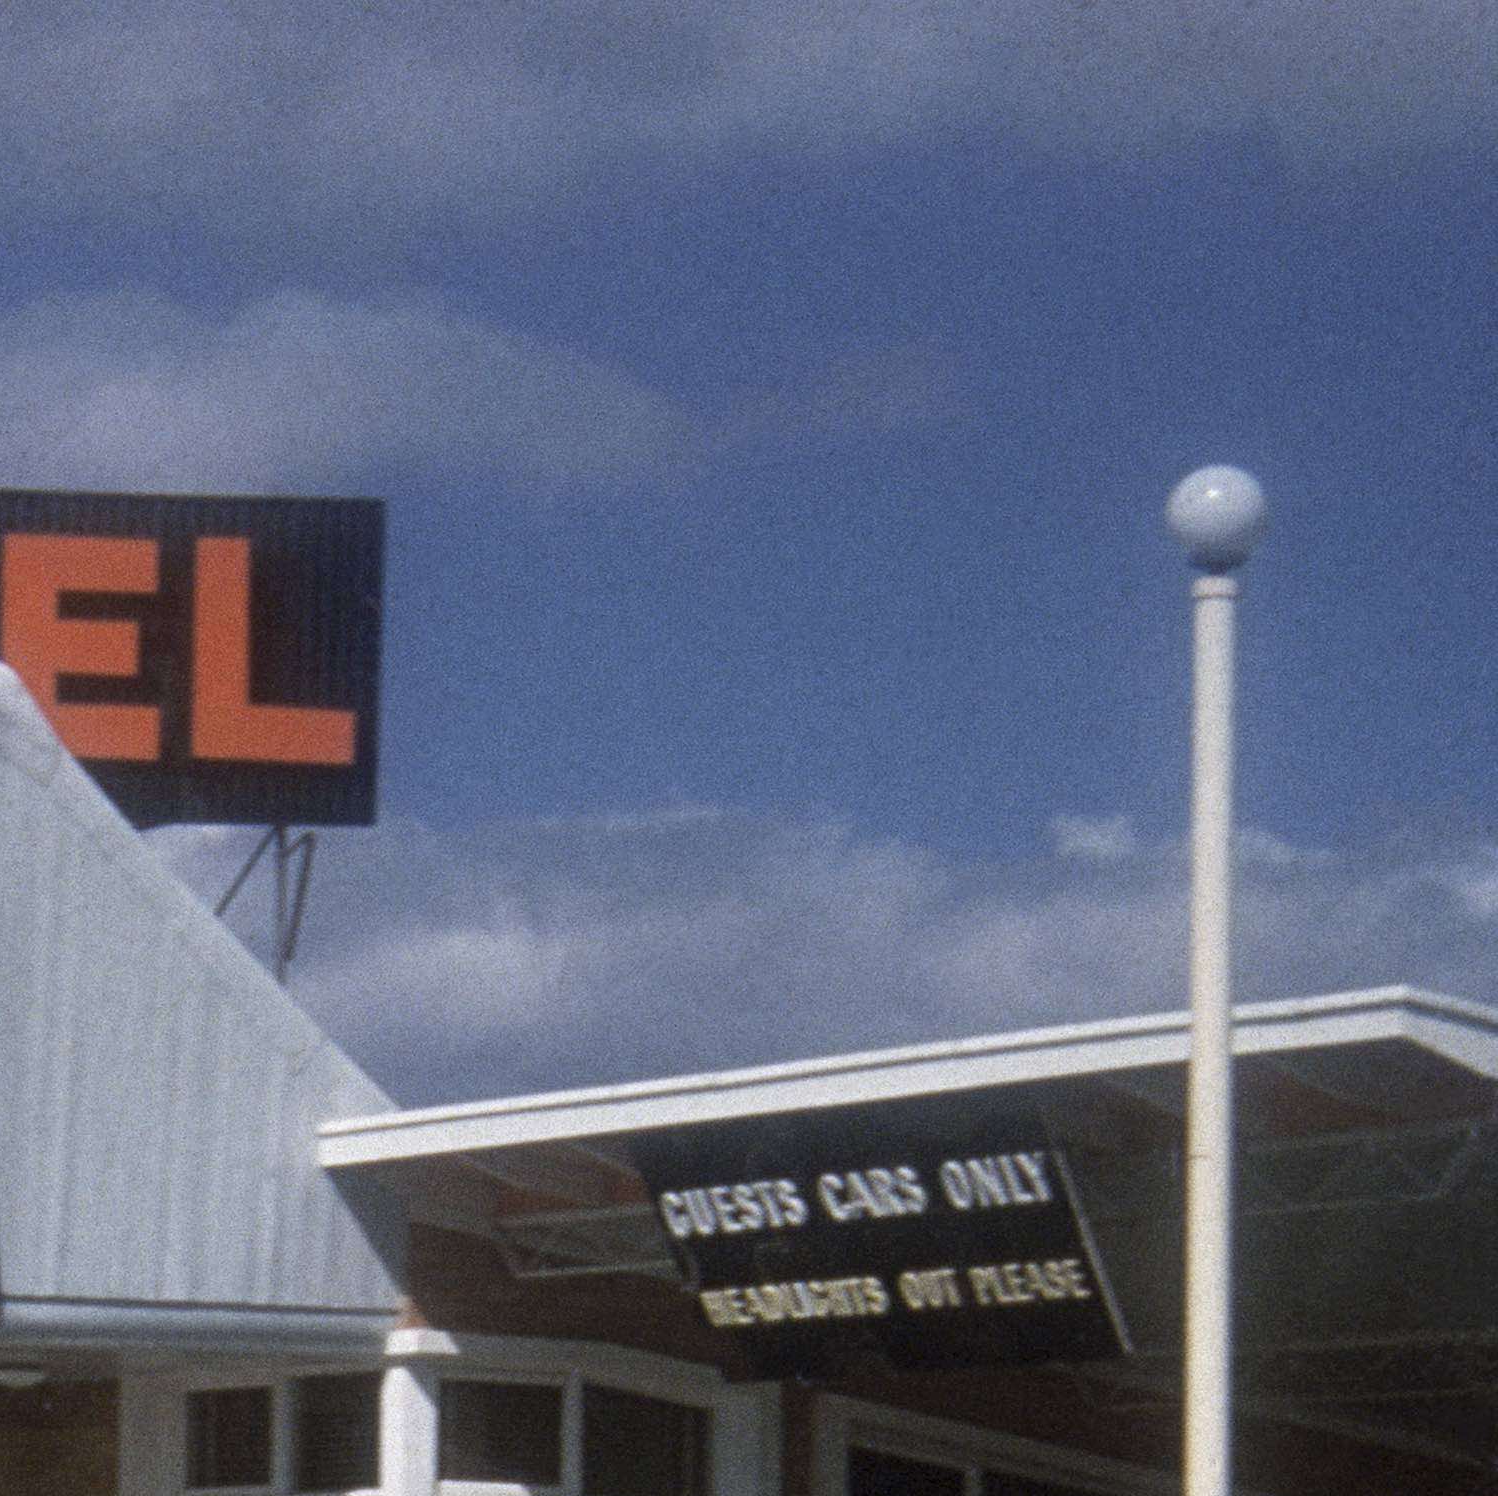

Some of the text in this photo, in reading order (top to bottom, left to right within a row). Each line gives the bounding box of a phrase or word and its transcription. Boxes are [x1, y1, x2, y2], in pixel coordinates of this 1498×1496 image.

[659, 1151, 1054, 1239] GUESTS CARS ONLY
[898, 1267, 961, 1310] OUT
[968, 1258, 1093, 1306] PLEASE
